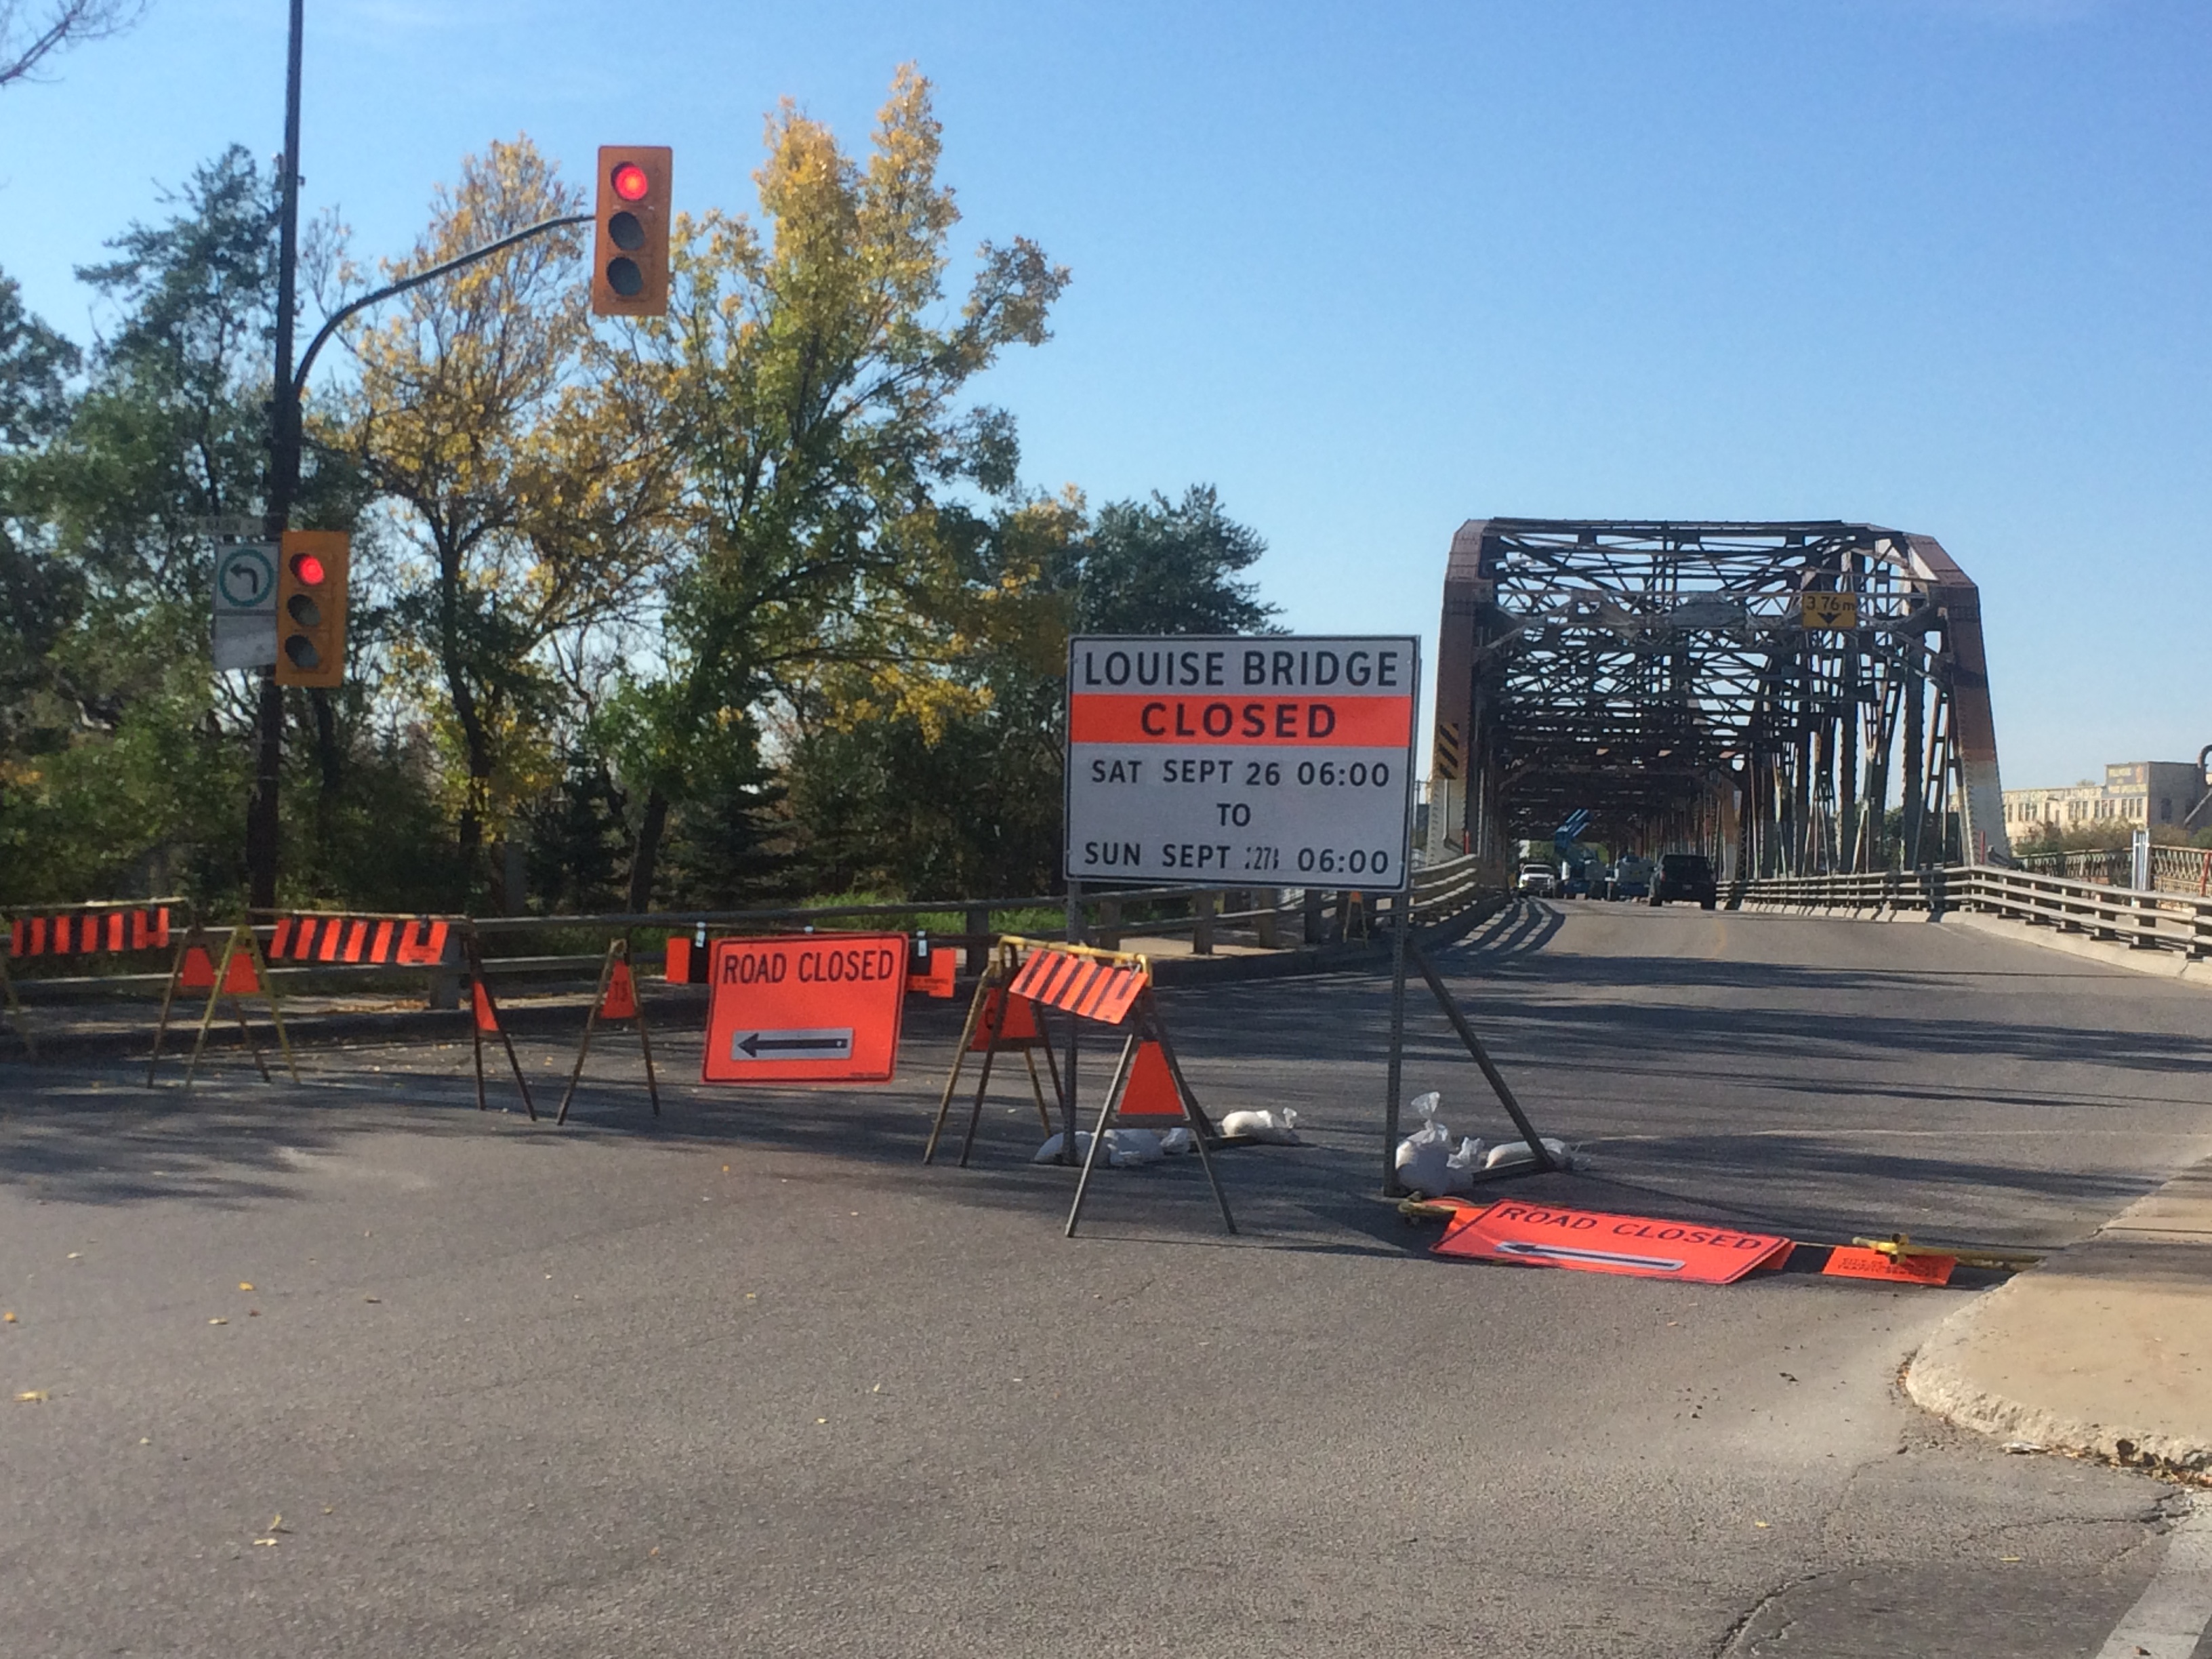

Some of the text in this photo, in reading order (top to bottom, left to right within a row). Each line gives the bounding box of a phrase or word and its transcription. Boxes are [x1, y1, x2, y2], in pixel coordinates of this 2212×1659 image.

[1086, 651, 1398, 687] LOUISE BRIDGE
[1141, 702, 1336, 738] CLOSED
[1092, 759, 1389, 787] SAT SEPT 26 06:00
[1216, 803, 1251, 827] TO
[1084, 842, 1141, 866] SUN
[1162, 844, 1231, 869] SEPT
[1298, 848, 1389, 874] 06:00
[723, 949, 894, 984] ROAD CLOSED
[1496, 1206, 1762, 1250] ROAD CLOSED
